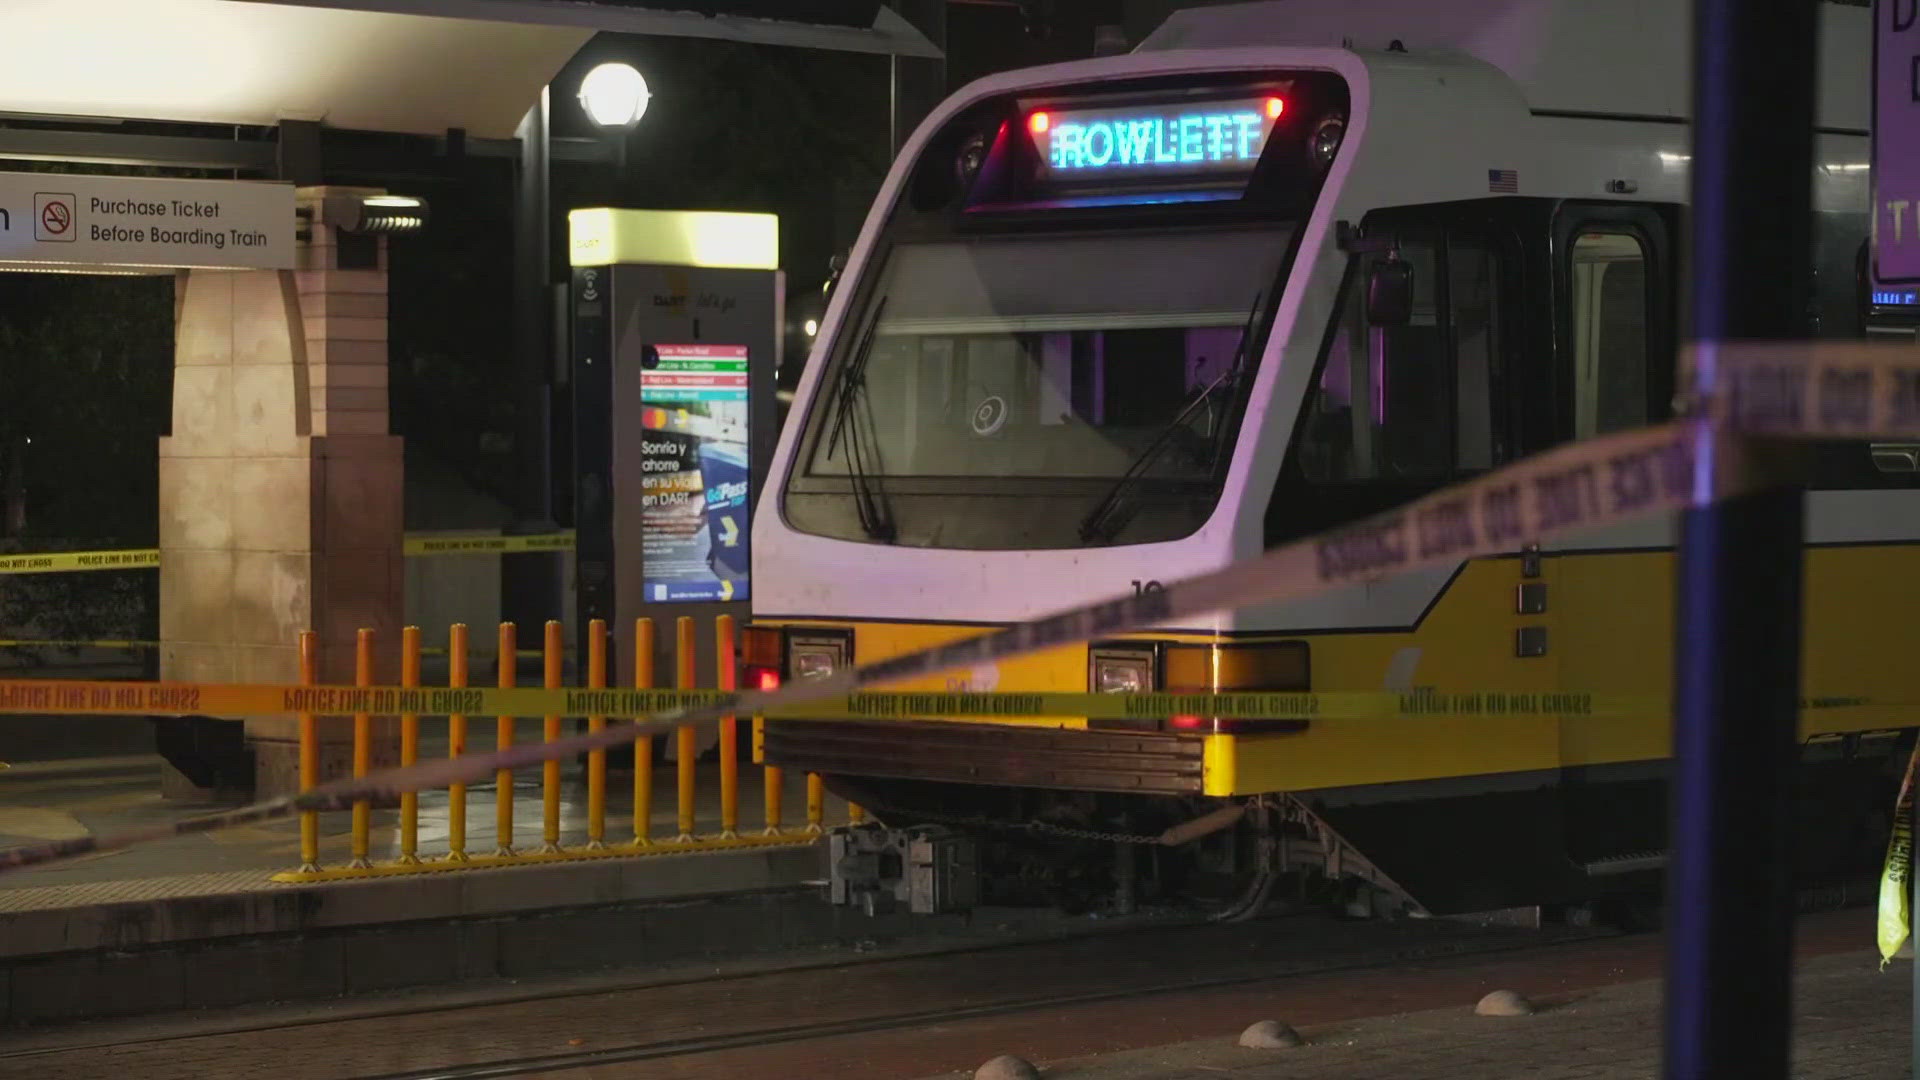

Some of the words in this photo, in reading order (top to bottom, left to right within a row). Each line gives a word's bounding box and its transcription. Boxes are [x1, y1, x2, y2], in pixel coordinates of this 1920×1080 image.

[1051, 111, 1262, 168] ROWLETT
[90, 198, 167, 217] Purchase
[172, 201, 220, 218] Ticket
[90, 226, 145, 243] Before
[150, 227, 225, 249] Boarding
[231, 230, 268, 247] Train
[642, 440, 677, 455] Sonría
[679, 443, 687, 457] y
[642, 459, 680, 472] ahorre
[642, 478, 658, 489] en
[642, 495, 658, 506] en
[12, 560, 26, 568] NOT
[28, 558, 53, 568] CROSS
[77, 556, 103, 565] POLICE
[105, 555, 120, 564] LINE
[122, 555, 132, 563] DO
[134, 554, 148, 562] NOT
